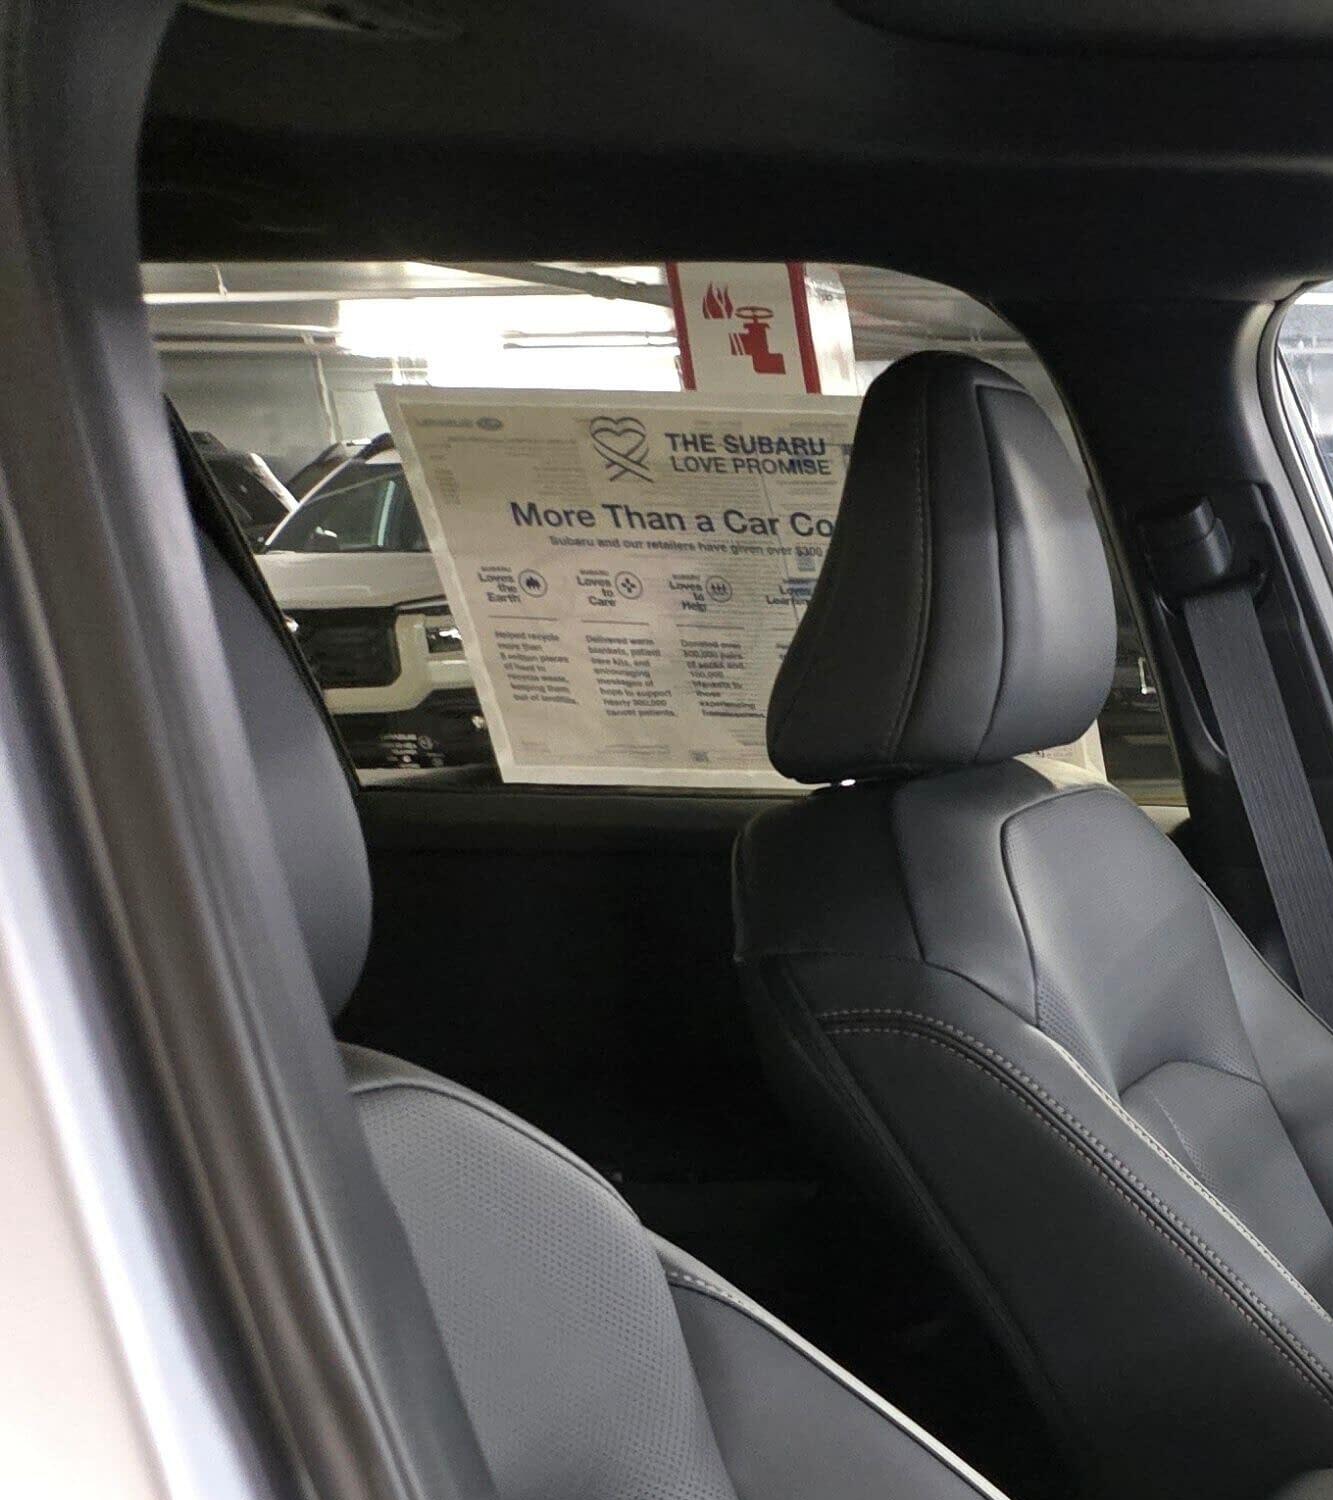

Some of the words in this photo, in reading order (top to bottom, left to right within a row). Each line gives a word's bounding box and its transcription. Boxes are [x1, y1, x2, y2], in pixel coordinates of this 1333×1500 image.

[665, 433, 716, 453] THE
[723, 434, 826, 456] SUBARU
[671, 456, 728, 473] LOVE
[733, 457, 832, 475] PROMISE
[510, 502, 595, 527] More
[602, 504, 686, 531] Than
[698, 513, 714, 532] a
[723, 509, 779, 535] Car
[550, 535, 594, 547] Subaru
[598, 538, 620, 548] and
[622, 540, 642, 549] our
[646, 541, 696, 551] retailers
[698, 542, 726, 552] have
[477, 572, 514, 583] Loves
[576, 576, 612, 588] Loves
[498, 583, 517, 593] the
[669, 581, 703, 592] Loves
[487, 592, 521, 603] Earth
[601, 588, 613, 597] to
[588, 596, 617, 607] Care
[682, 600, 707, 612] Help
